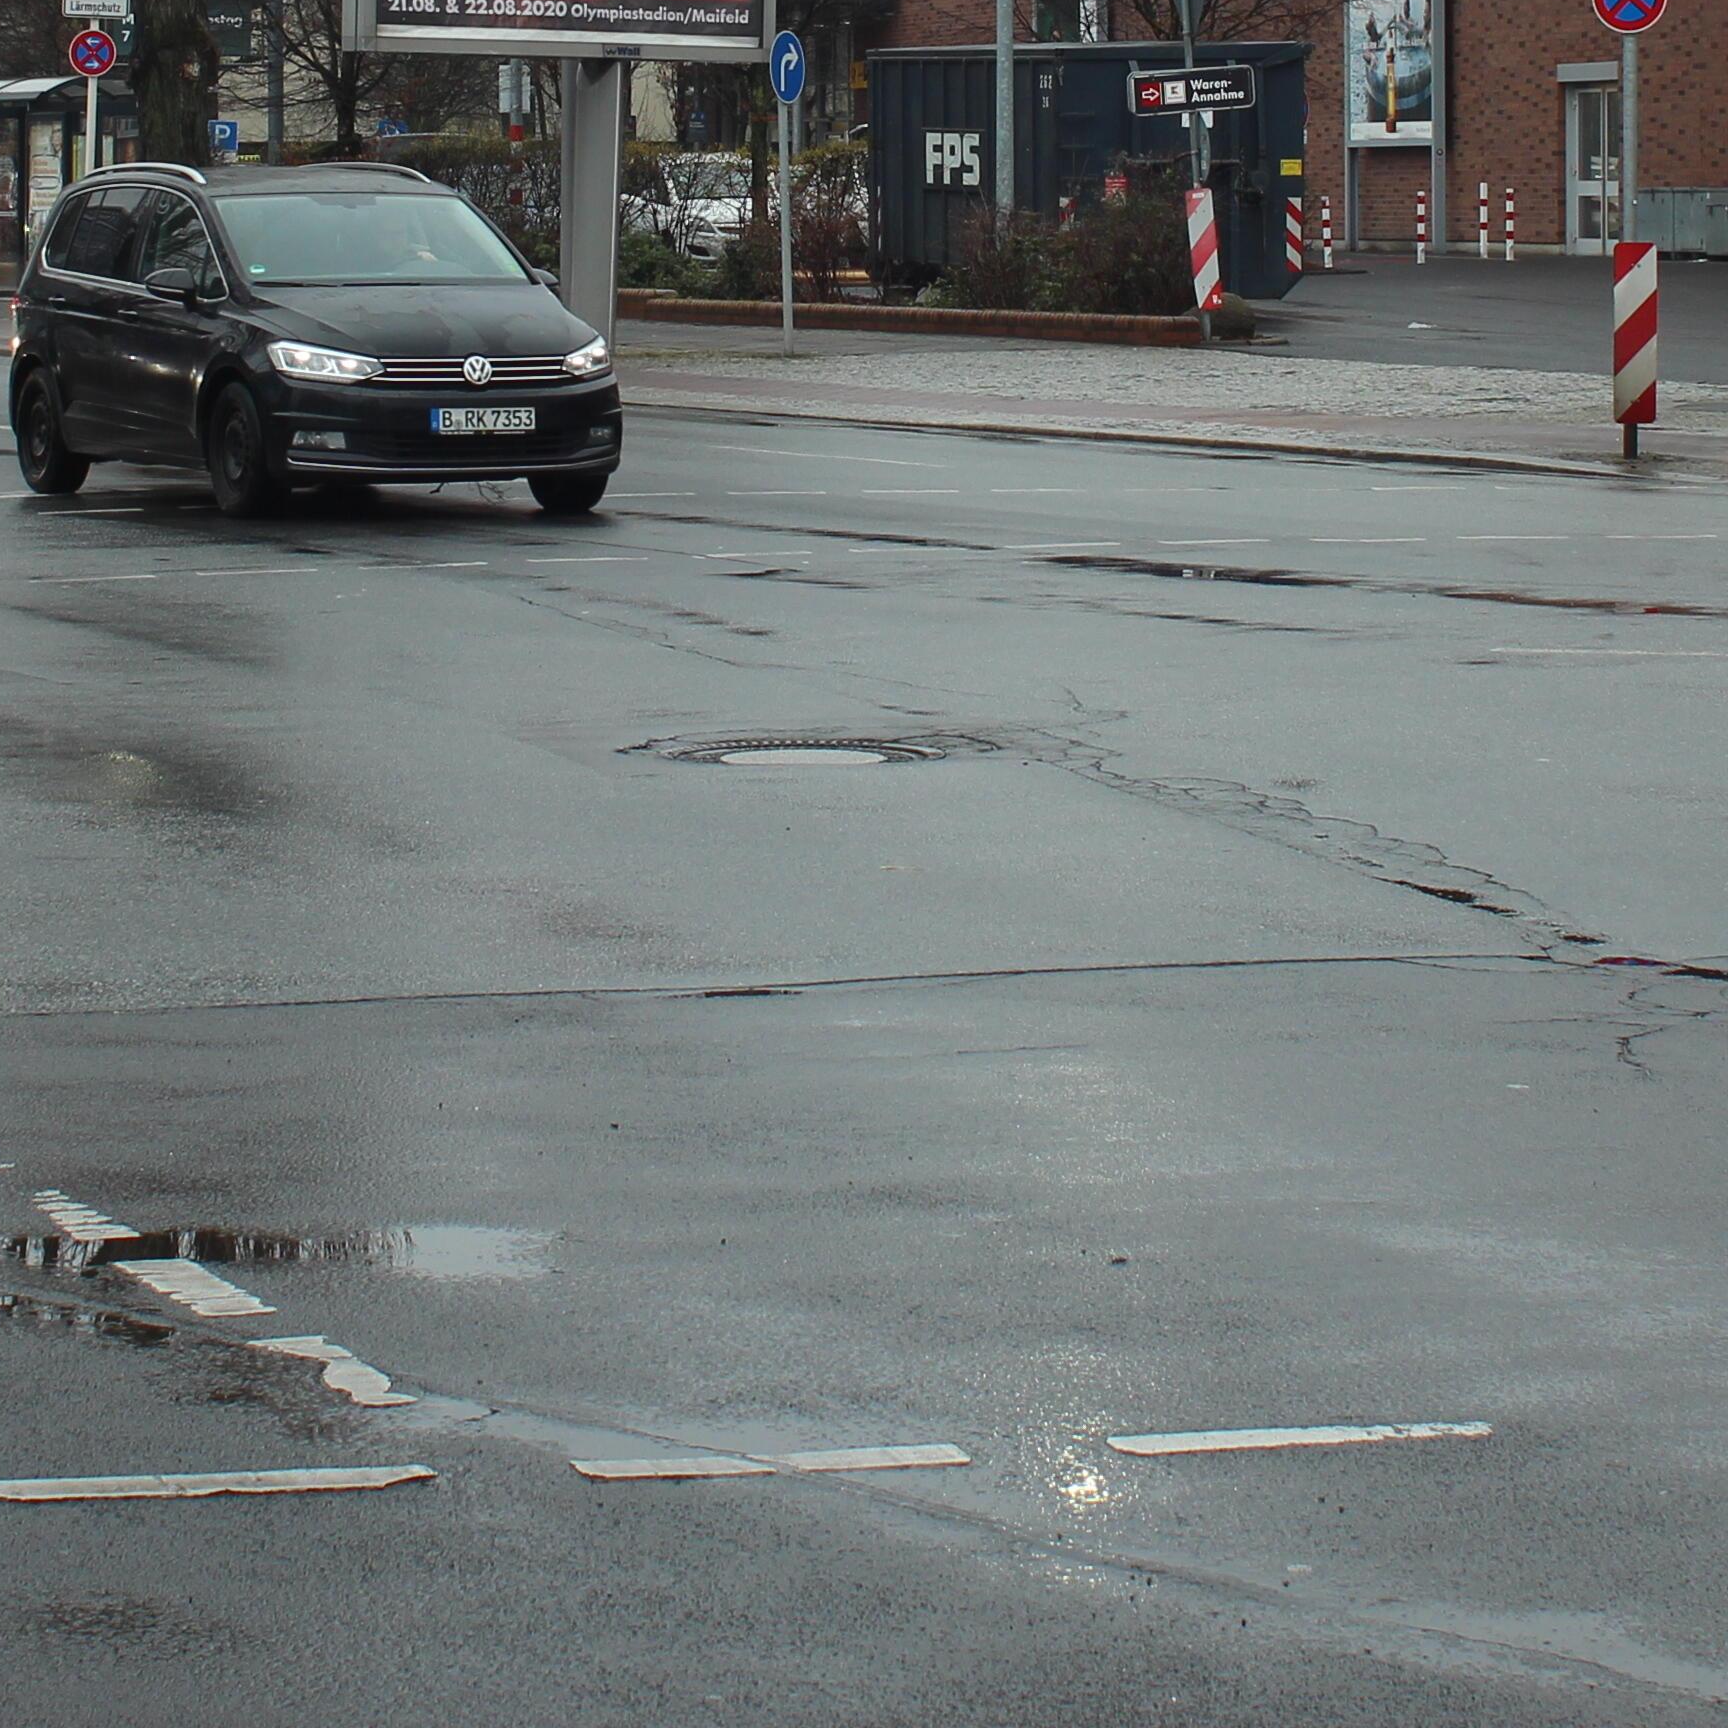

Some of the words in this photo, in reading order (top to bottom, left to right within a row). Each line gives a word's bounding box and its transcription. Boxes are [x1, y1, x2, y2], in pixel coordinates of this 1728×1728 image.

[70, 0, 122, 13] Lärmschutz
[571, 3, 749, 25] Olympiastadion/Maifeld
[1190, 78, 1232, 91] Waren-
[1191, 89, 1245, 103] Annahme
[925, 131, 981, 186] FPS
[442, 410, 453, 428] B
[465, 410, 487, 428] RK
[491, 410, 533, 428] 7353
